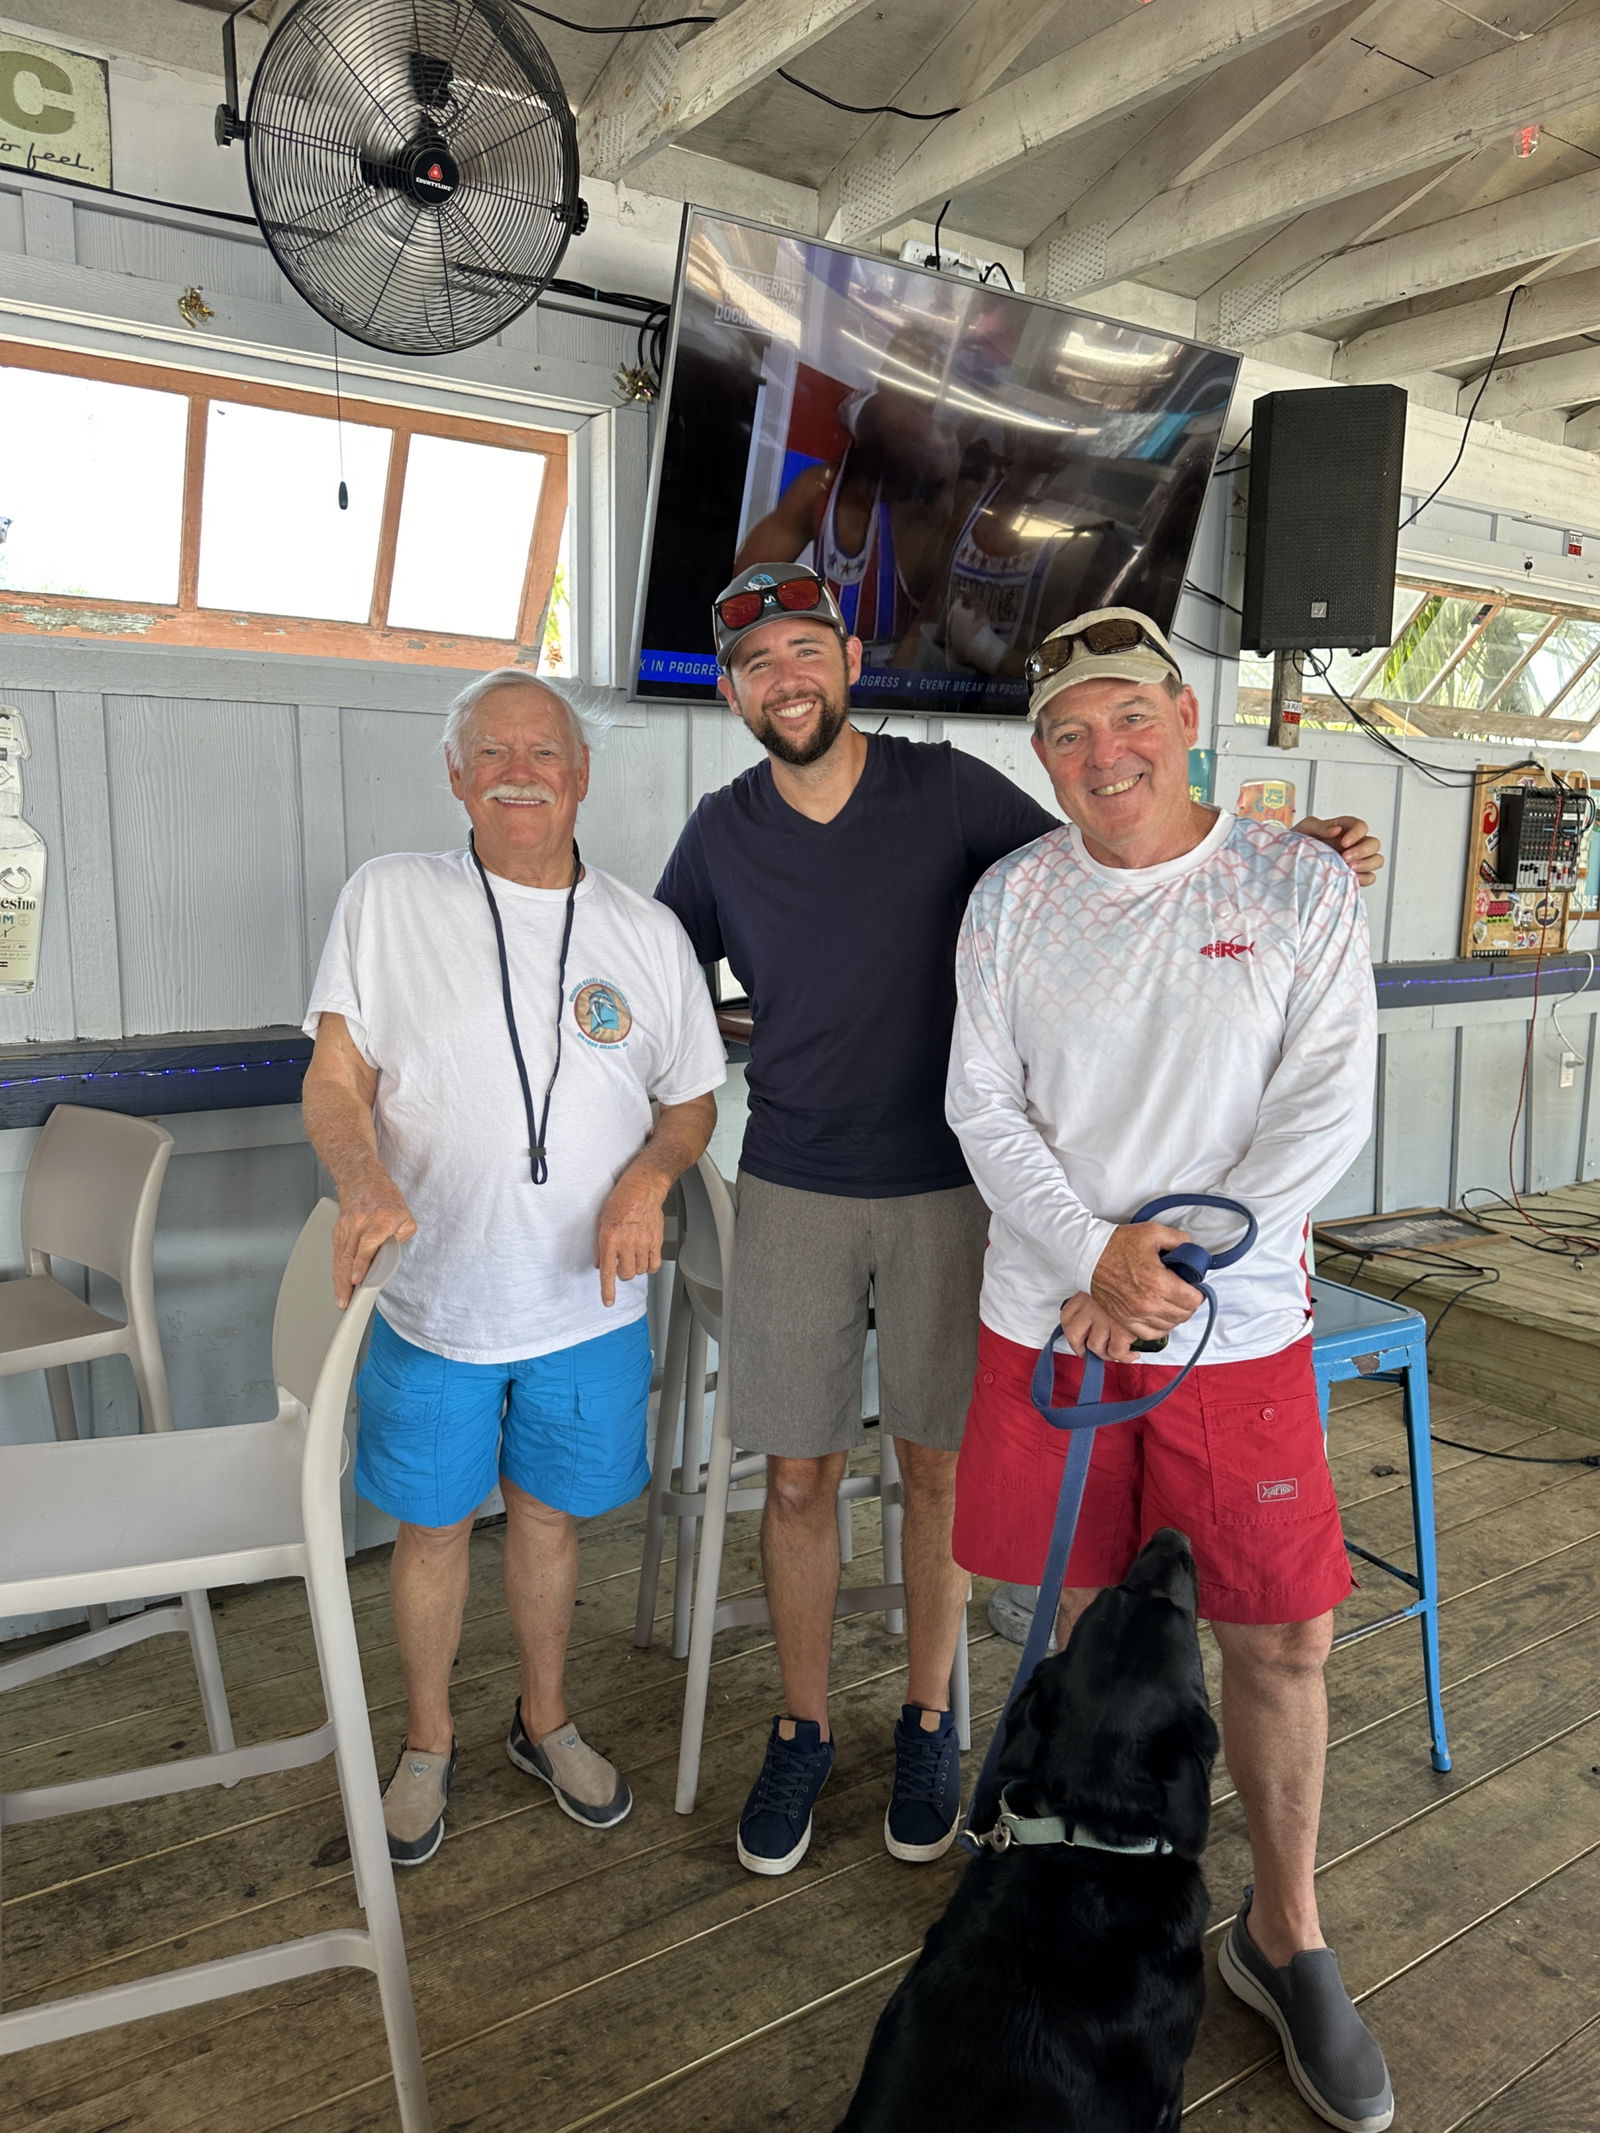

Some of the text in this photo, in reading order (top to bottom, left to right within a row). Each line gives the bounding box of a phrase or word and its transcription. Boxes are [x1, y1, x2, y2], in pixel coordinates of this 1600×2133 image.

[27, 142, 94, 171] feel.
[651, 660, 663, 672] IN
[669, 661, 723, 676] PROGRES
[919, 678, 950, 691] EVENT
[952, 680, 985, 693] BREAK
